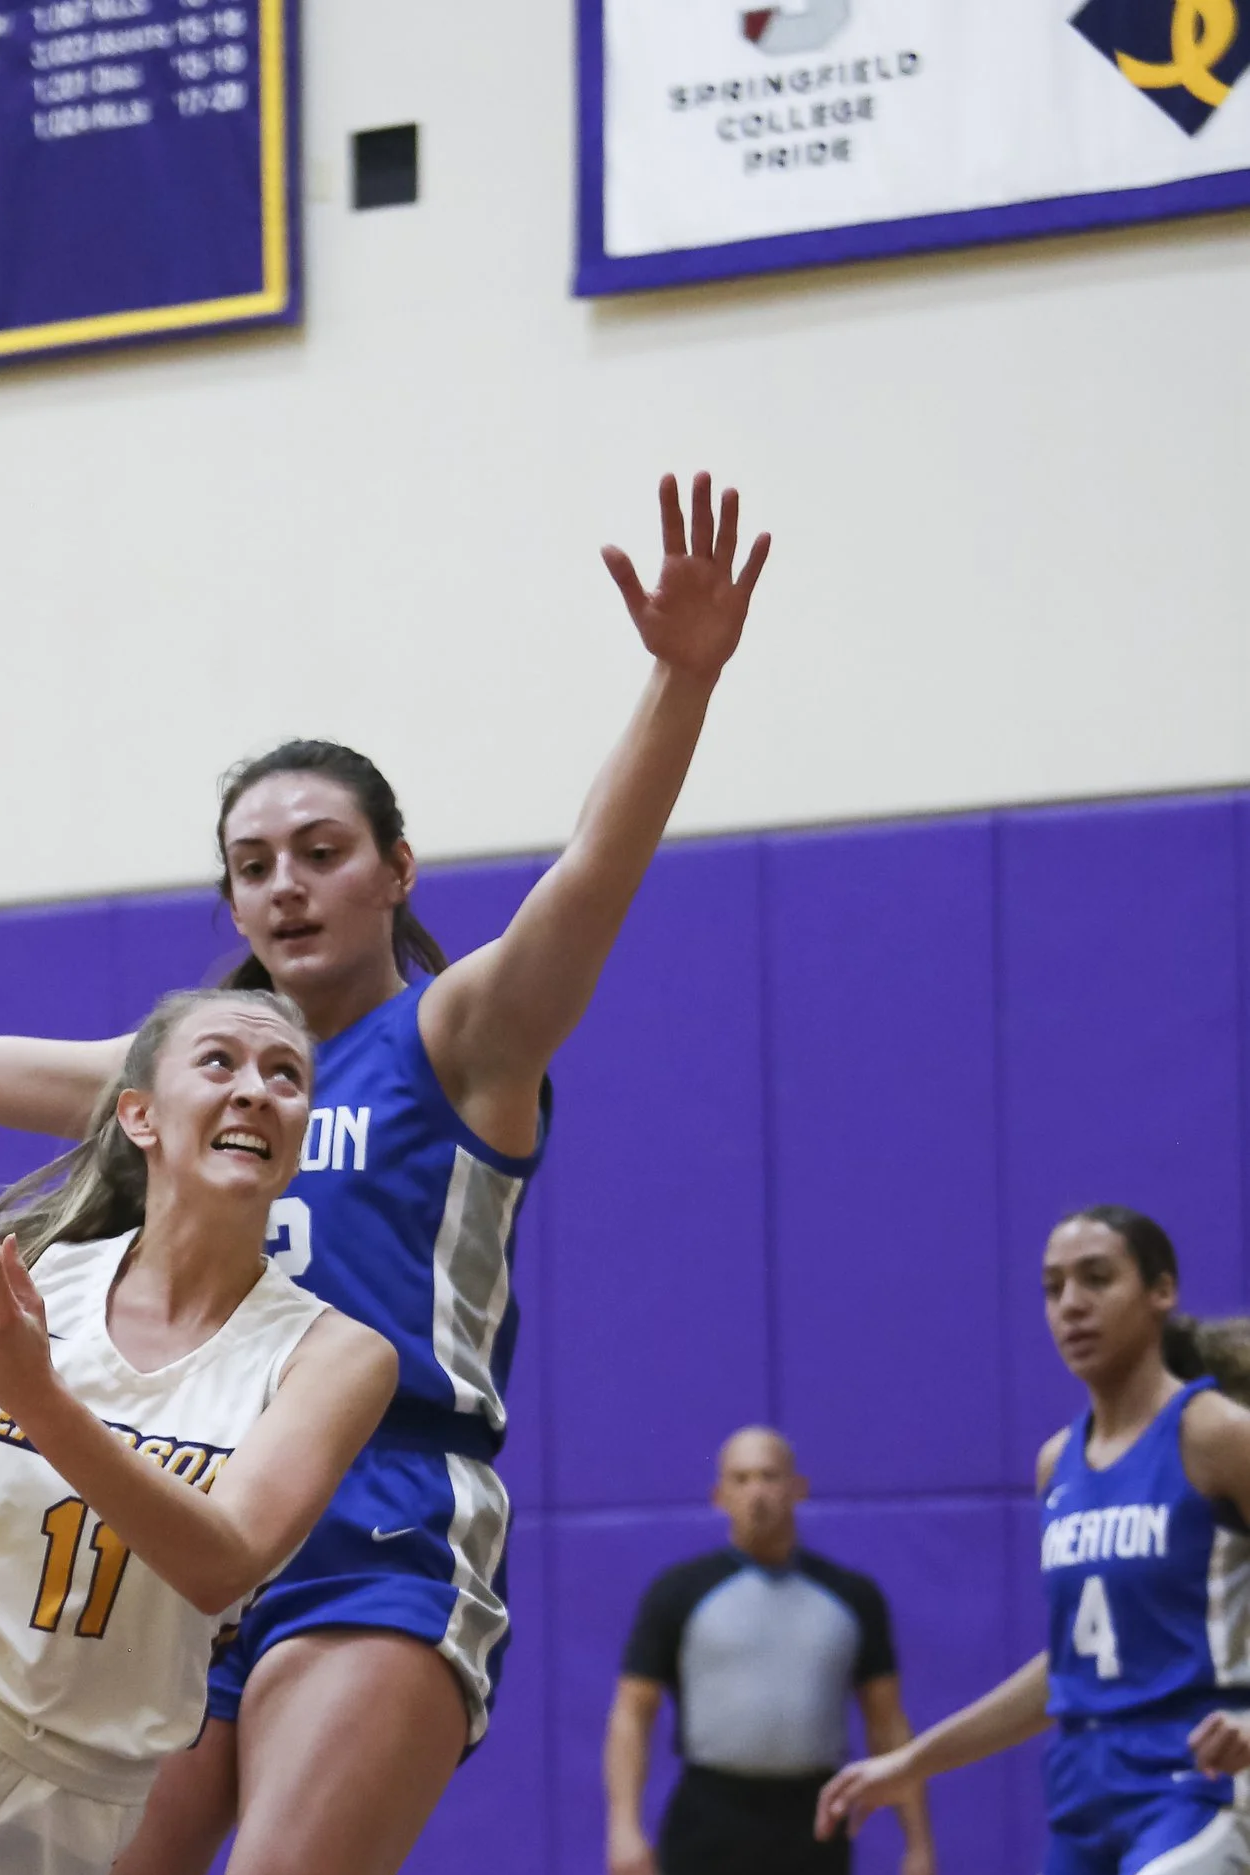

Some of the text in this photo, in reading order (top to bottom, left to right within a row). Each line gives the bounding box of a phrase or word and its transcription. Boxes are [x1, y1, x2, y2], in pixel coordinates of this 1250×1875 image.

[668, 51, 923, 112] SPRINGFIELD
[715, 97, 875, 142] COLLEGE
[743, 137, 850, 177] PRIDE
[300, 1105, 372, 1172] ON
[29, 1495, 131, 1639] 11
[1072, 1574, 1121, 1680] 4
